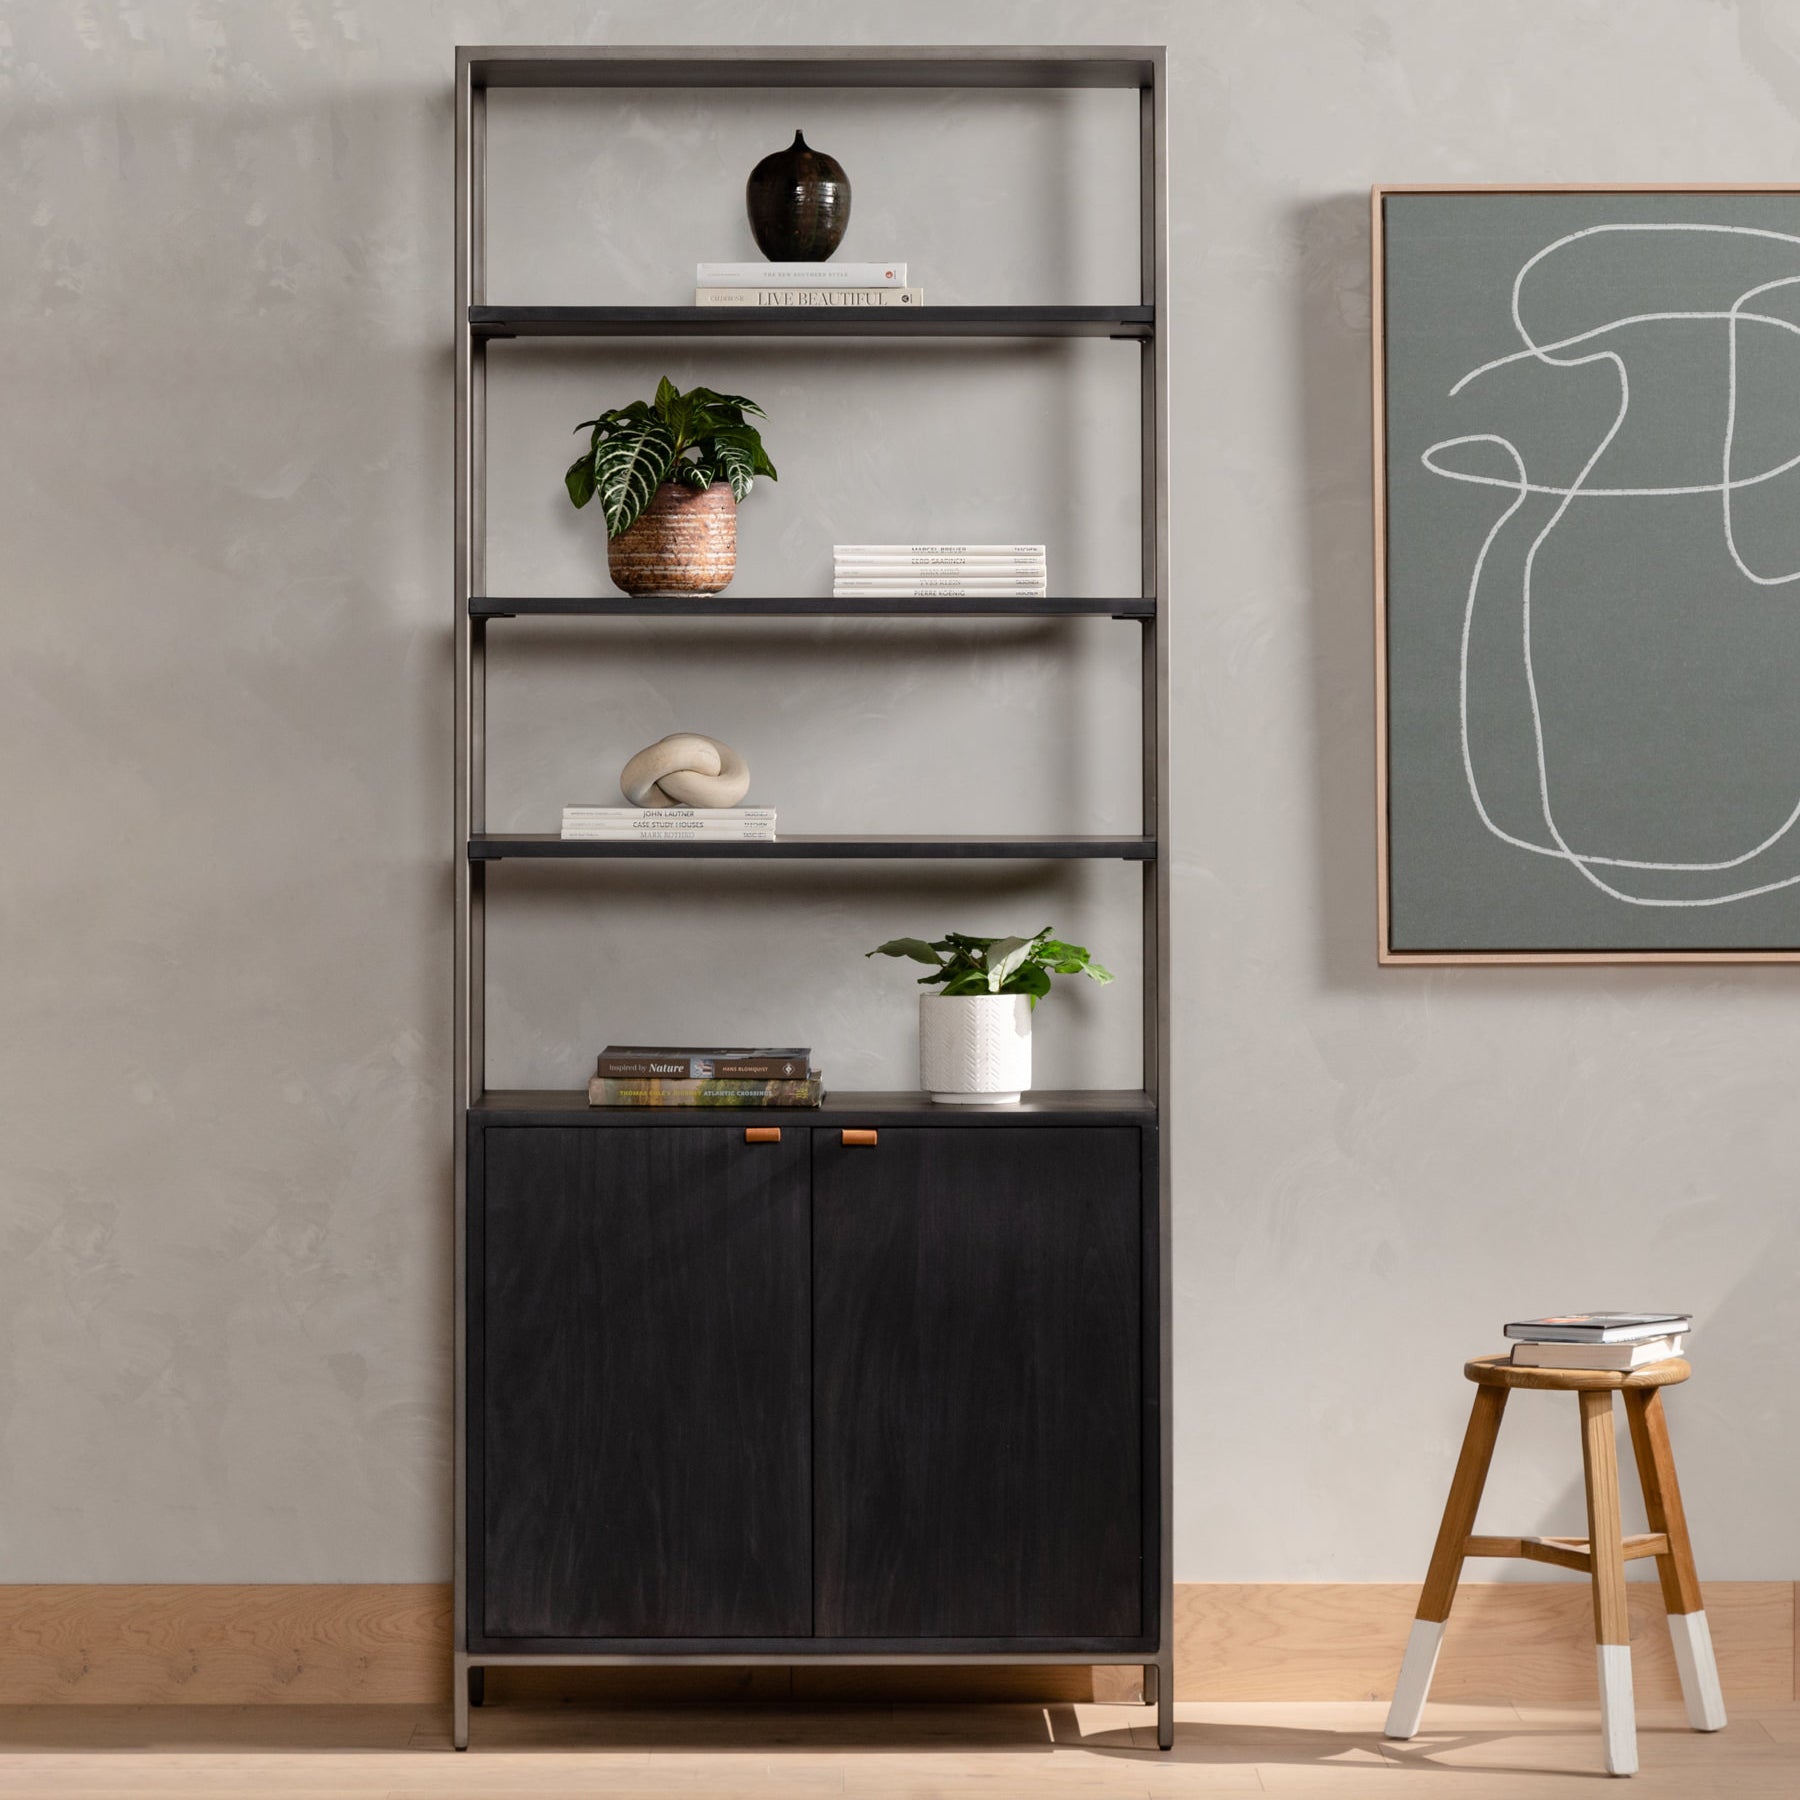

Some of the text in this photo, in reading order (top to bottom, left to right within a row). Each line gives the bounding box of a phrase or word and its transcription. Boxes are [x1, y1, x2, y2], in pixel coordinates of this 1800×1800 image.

[758, 292, 794, 306] LIVE
[798, 292, 888, 306] BEAUTIFUL
[643, 810, 663, 818] JOHN
[609, 1063, 685, 1073] Inspired by Nature
